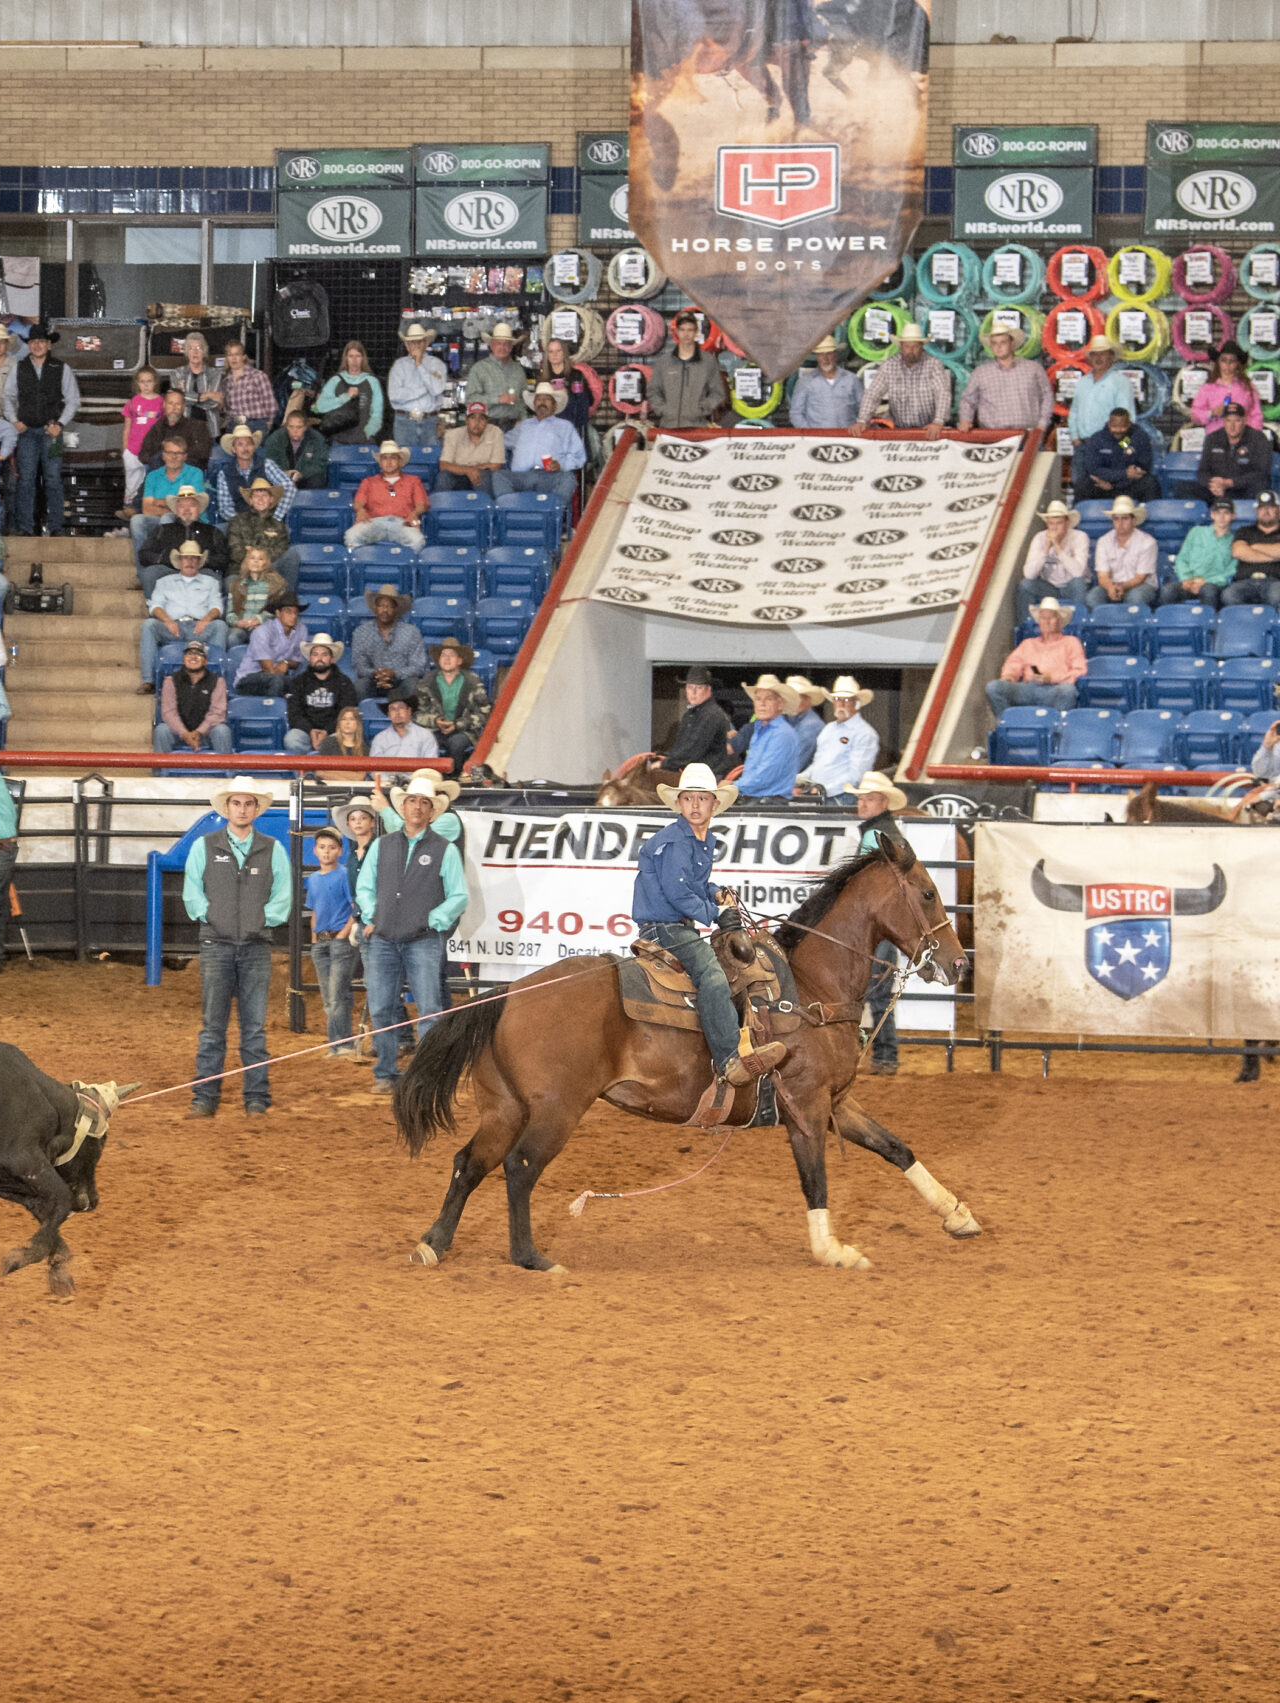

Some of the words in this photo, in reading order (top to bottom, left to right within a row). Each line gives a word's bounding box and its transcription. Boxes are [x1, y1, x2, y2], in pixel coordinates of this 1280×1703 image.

[968, 135, 995, 155] NRS
[1002, 141, 1087, 152] 800-GO-ROPIN
[1161, 131, 1189, 152] NRS
[1196, 138, 1280, 150] 800-GO-ROPIN
[593, 142, 619, 162] NRS
[290, 159, 316, 178] NRS
[323, 164, 404, 174] 800-GO-ROPIN
[429, 153, 454, 173] NRS
[461, 159, 541, 169] 800-GO-ROPIN
[740, 163, 820, 206] HP
[999, 179, 1048, 213] NRS
[1190, 176, 1242, 211] NRS
[320, 201, 368, 235] NRS
[457, 197, 505, 230] NRS
[964, 221, 1082, 234] NRSworld.com
[1155, 218, 1275, 232] NRSworld.com
[288, 243, 401, 255] NRSworld.com
[425, 238, 538, 250] NRSworld.com
[671, 237, 774, 252] HORSE
[787, 236, 888, 251] POWER
[736, 260, 822, 271] BOOTS
[664, 445, 704, 462] NRS
[751, 442, 795, 451] Things
[817, 445, 855, 462] NRS
[904, 443, 949, 452] Things
[731, 452, 786, 461] Western
[882, 453, 940, 462] Western
[969, 446, 1008, 462] NRS
[676, 471, 720, 482] Things
[817, 474, 864, 482] Things
[963, 468, 1006, 479] Things
[656, 476, 711, 490] Western
[736, 474, 774, 490] NRS
[799, 482, 854, 491] Western
[879, 476, 919, 492] NRS
[943, 478, 998, 489] Western
[644, 494, 683, 511] NRS
[732, 502, 778, 510] Things
[887, 502, 932, 510] Things
[953, 495, 992, 512] NRS
[714, 510, 768, 519] Western
[798, 505, 838, 521] NRS
[868, 510, 923, 519] Western
[657, 519, 703, 534] Things
[943, 515, 988, 531] Things
[636, 525, 692, 541] Western
[717, 530, 756, 546] NRS
[801, 530, 846, 538] Things
[861, 529, 900, 546] NRS
[925, 525, 979, 539] Western
[781, 538, 836, 546] Western
[625, 545, 663, 562] NRS
[714, 552, 758, 563] Things
[869, 551, 914, 561] Things
[934, 543, 972, 560] NRS
[693, 558, 749, 570] Western
[779, 558, 819, 573] NRS
[849, 560, 904, 570] Western
[635, 568, 682, 580] Things
[926, 565, 970, 578] Things
[696, 578, 736, 593] NRS
[782, 581, 827, 589] Things
[840, 578, 881, 593] NRS
[906, 573, 960, 587] Western
[604, 587, 643, 602] NRS
[761, 588, 816, 596] Western
[671, 602, 728, 616] Western
[693, 597, 739, 610] Things
[850, 598, 895, 608] Things
[759, 605, 799, 621] NRS
[830, 606, 884, 616] Western
[1091, 887, 1166, 912] USTRC
[497, 909, 633, 937] 940-6
[449, 939, 471, 954] 841
[477, 941, 490, 955] N.
[495, 941, 514, 956] US
[520, 943, 541, 957] 287
